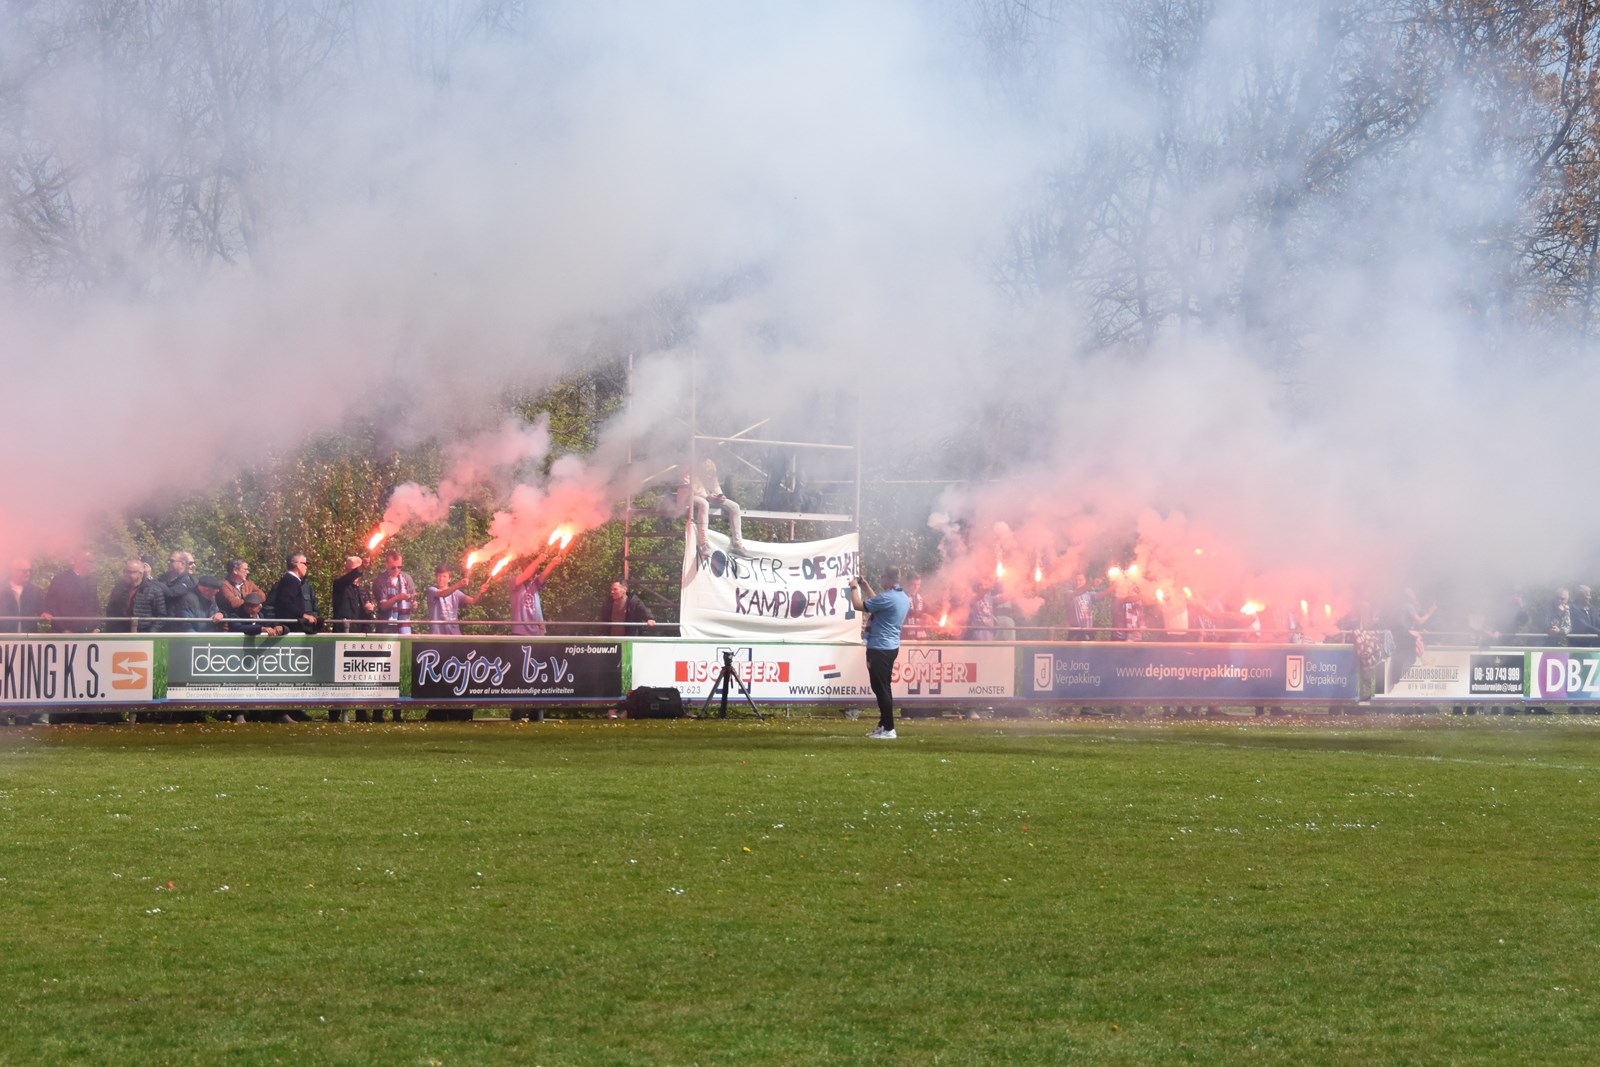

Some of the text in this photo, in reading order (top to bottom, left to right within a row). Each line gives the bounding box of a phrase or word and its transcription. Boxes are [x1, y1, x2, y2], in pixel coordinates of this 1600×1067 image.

[696, 545, 787, 584] MONSTER
[802, 555, 827, 580] DE
[735, 587, 838, 618] KAMPIOEN!
[565, 645, 618, 655] rojos-bouw.nl
[194, 643, 310, 679] decorette
[343, 659, 391, 673] sikkens
[1055, 660, 1089, 673] De Jong
[1306, 661, 1337, 674] De Jong
[0, 643, 105, 699] KING K.S.
[416, 645, 575, 696] Rojos b.v.
[891, 662, 968, 683] SOMEER
[1116, 664, 1272, 681] www.dejongverpakking.com
[1400, 668, 1459, 680] UKADOORSBEDRIJF
[1485, 667, 1494, 681] 50
[1494, 667, 1507, 681] 743
[1546, 659, 1600, 692] DBZ
[1055, 674, 1100, 686] Verpakking
[1306, 674, 1347, 686] Verpakking
[501, 687, 540, 695] bouwkundige
[687, 686, 700, 695] 623
[789, 686, 872, 696] WWW.ISOMEER.NL
[968, 686, 1005, 695] MONSTER
